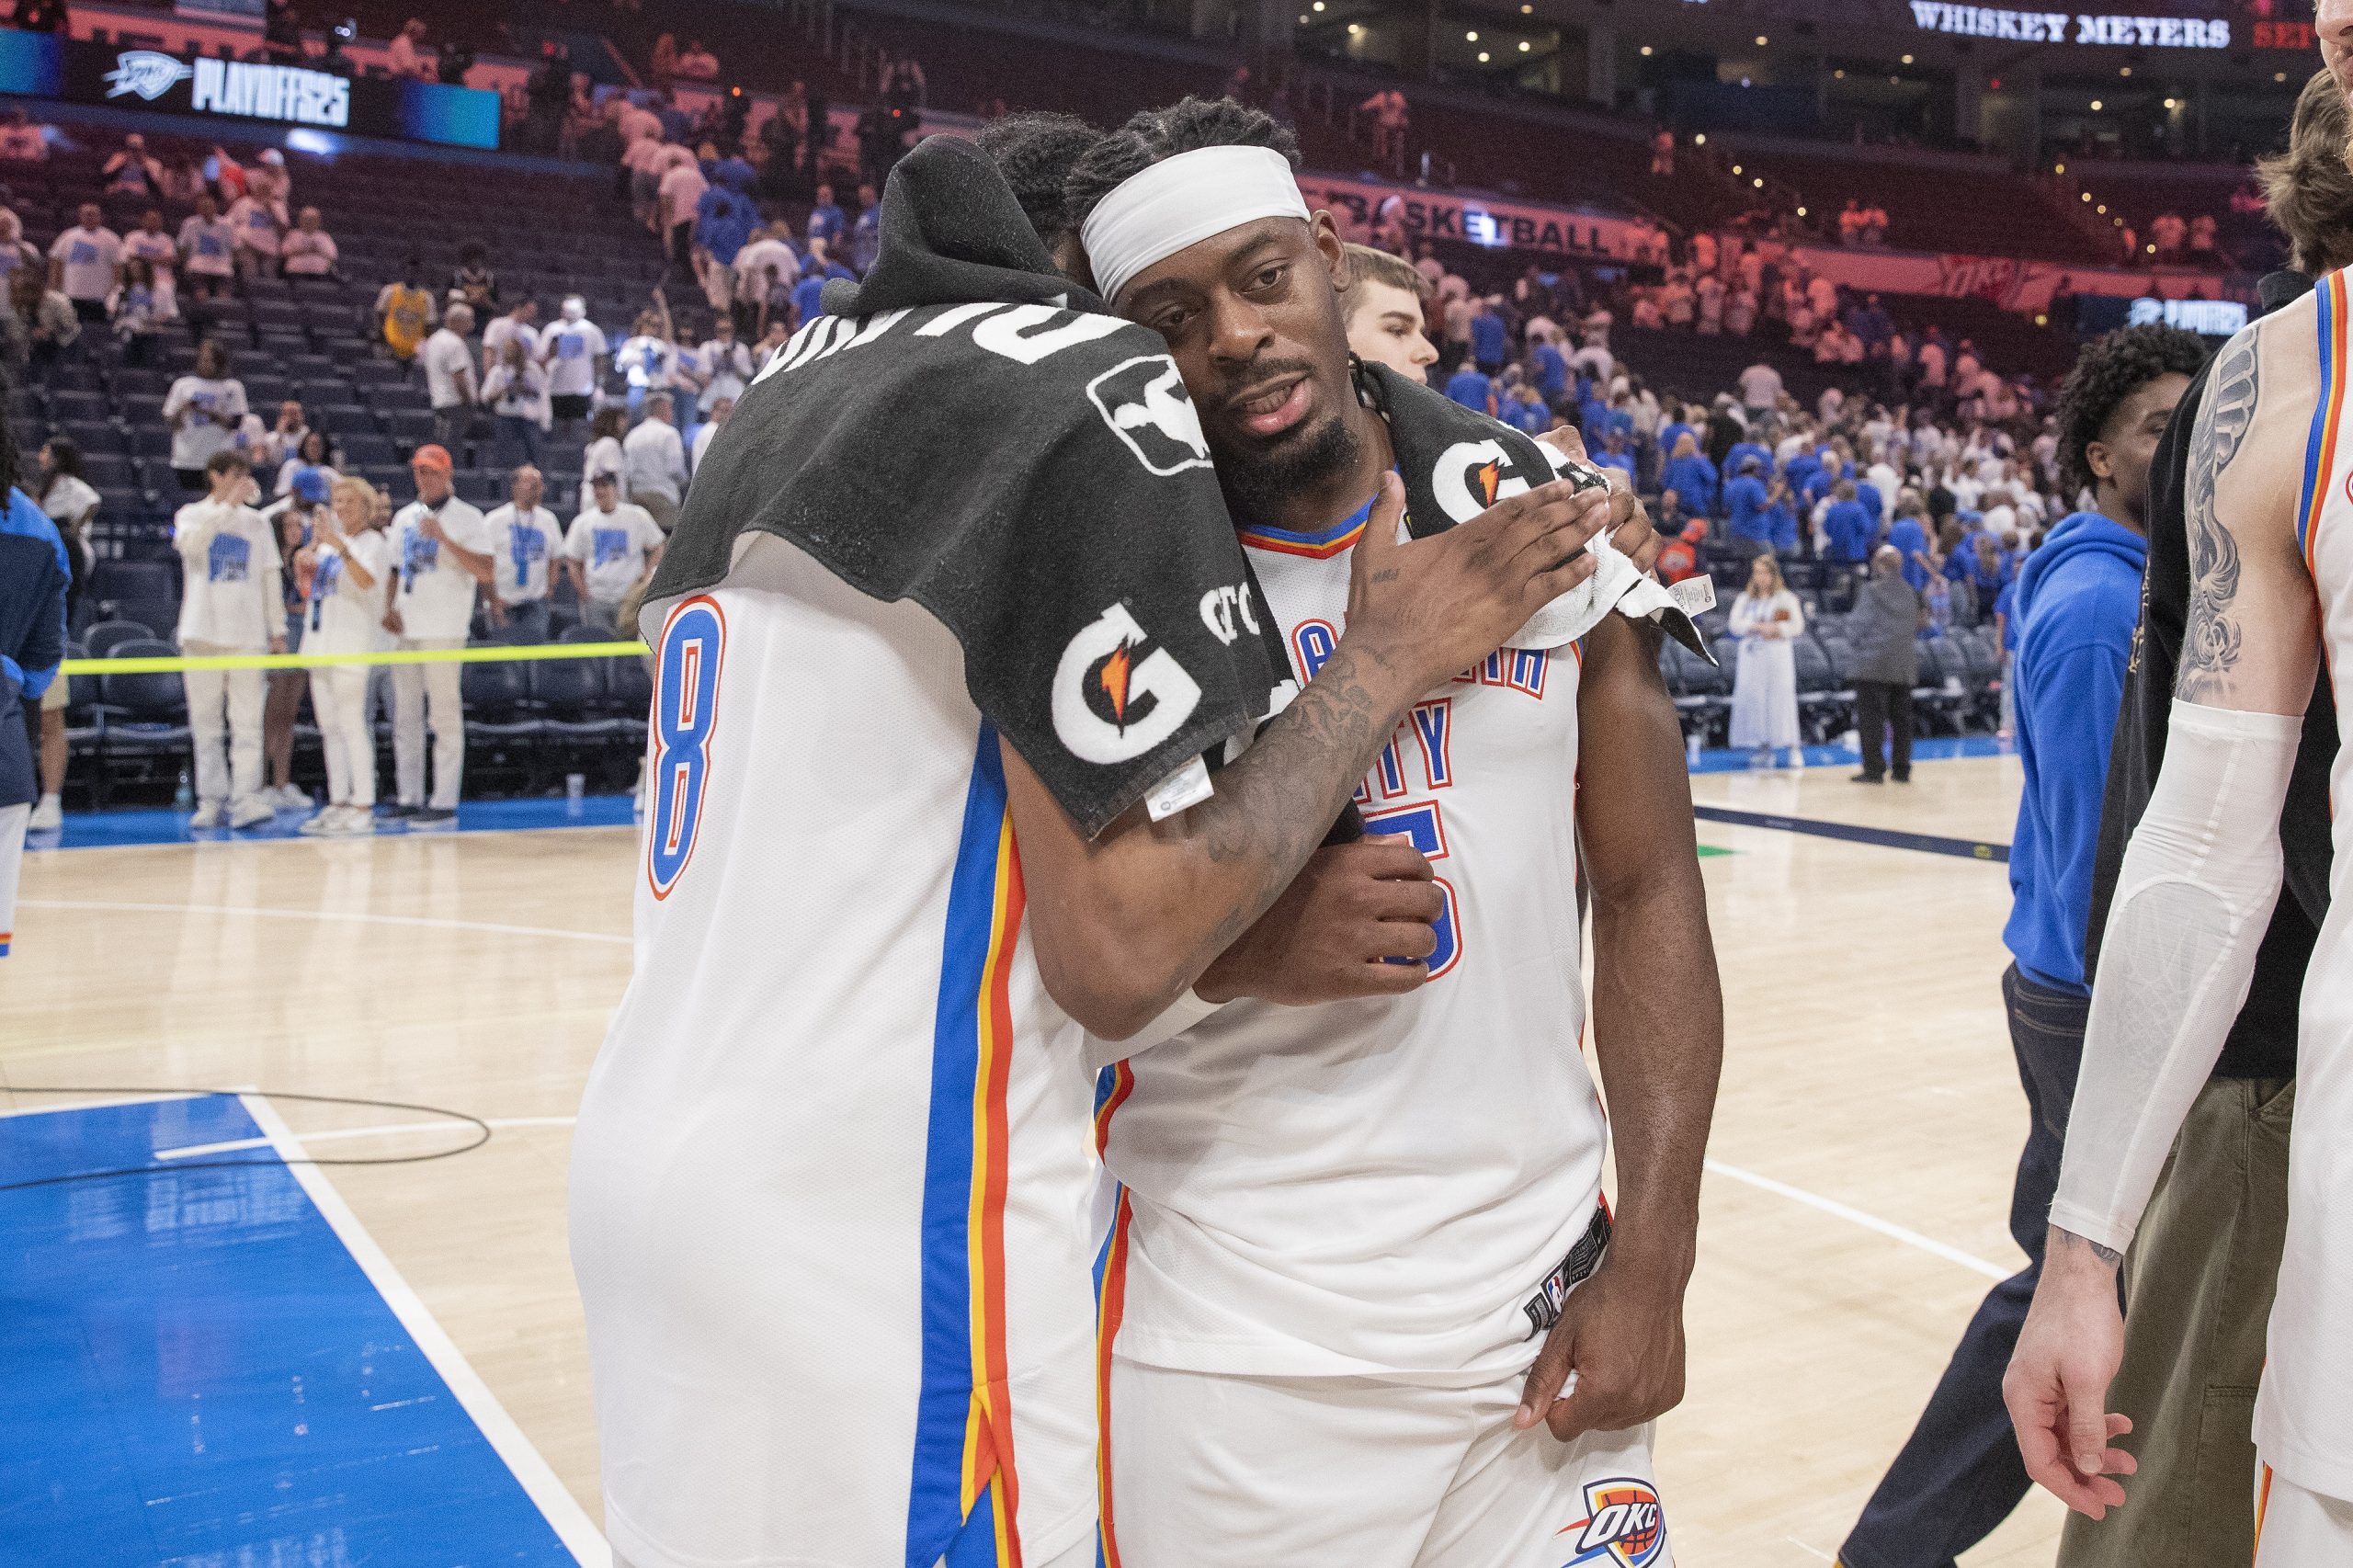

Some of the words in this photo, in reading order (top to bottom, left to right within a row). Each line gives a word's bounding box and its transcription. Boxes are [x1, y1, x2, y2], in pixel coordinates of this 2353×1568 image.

[1909, 0, 2068, 43] WHISKEY
[2075, 15, 2231, 49] MEYERS
[1051, 602, 1202, 765] G
[648, 594, 727, 901] 8
[1581, 1503, 1657, 1549] OKC
